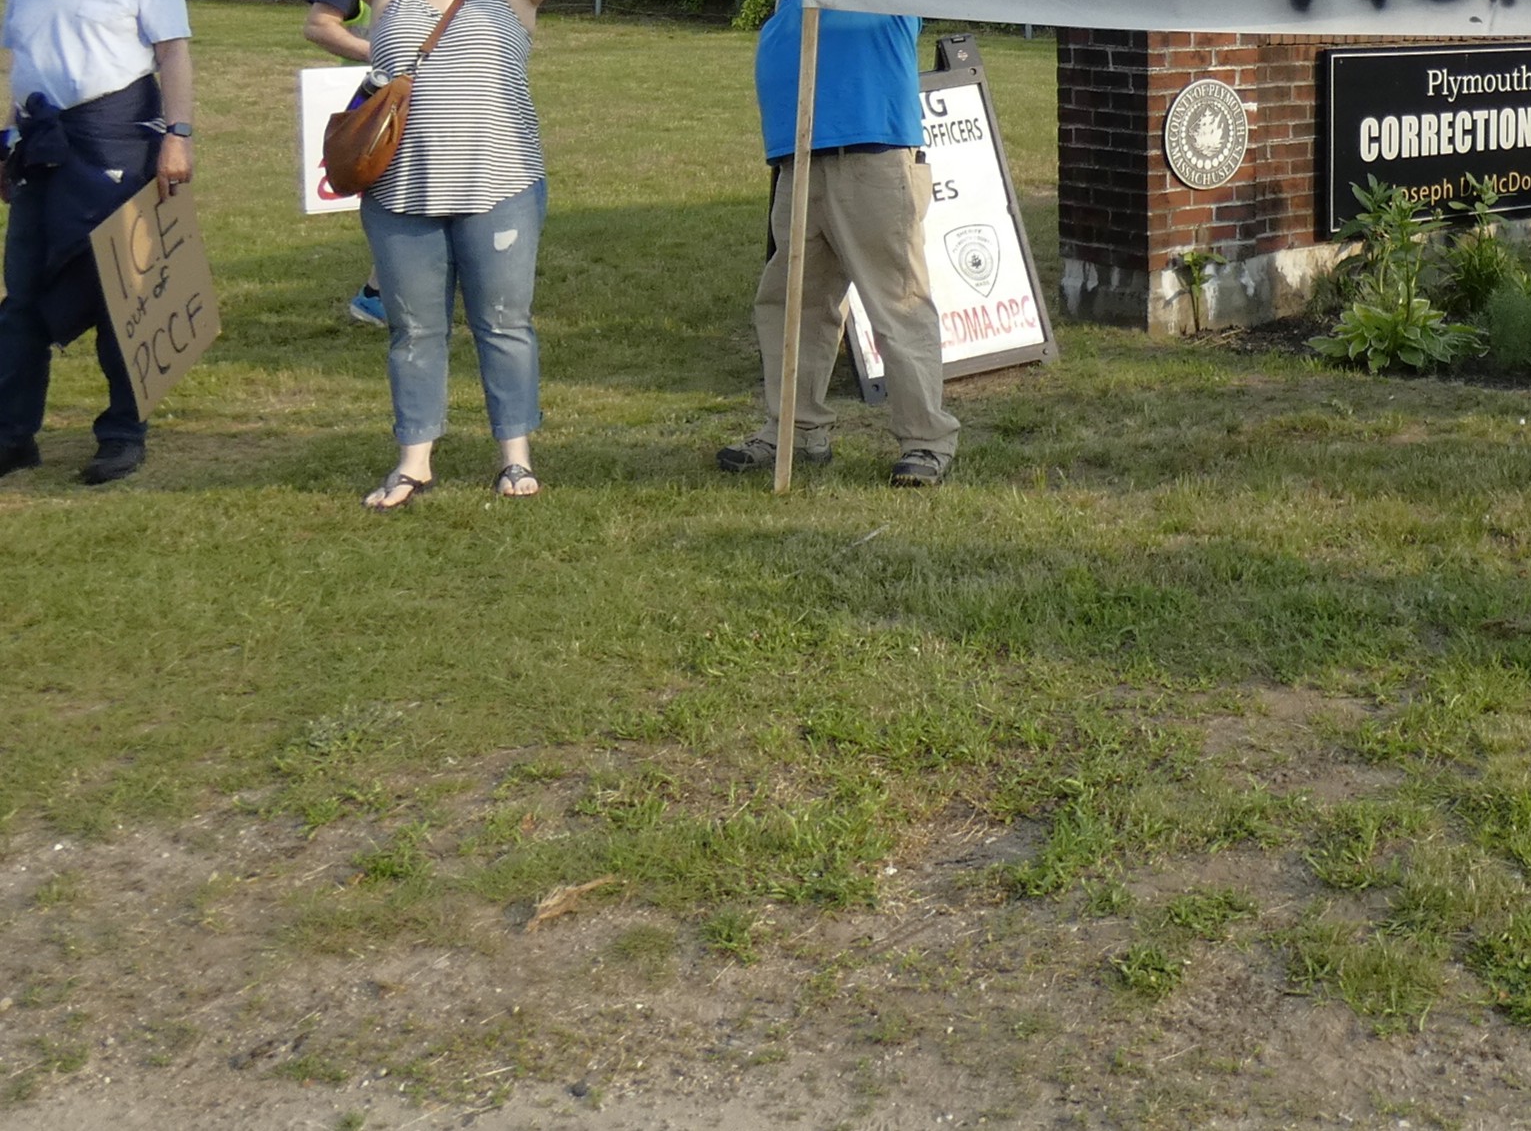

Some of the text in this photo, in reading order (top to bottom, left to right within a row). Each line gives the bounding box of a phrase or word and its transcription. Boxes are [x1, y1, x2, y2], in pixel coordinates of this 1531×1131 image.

[1169, 83, 1246, 141] COUNTY OF PLYMOUTH
[1170, 145, 1243, 186] MASSACHUSETTS
[1460, 176, 1477, 197] D.
[153, 265, 170, 299] of
